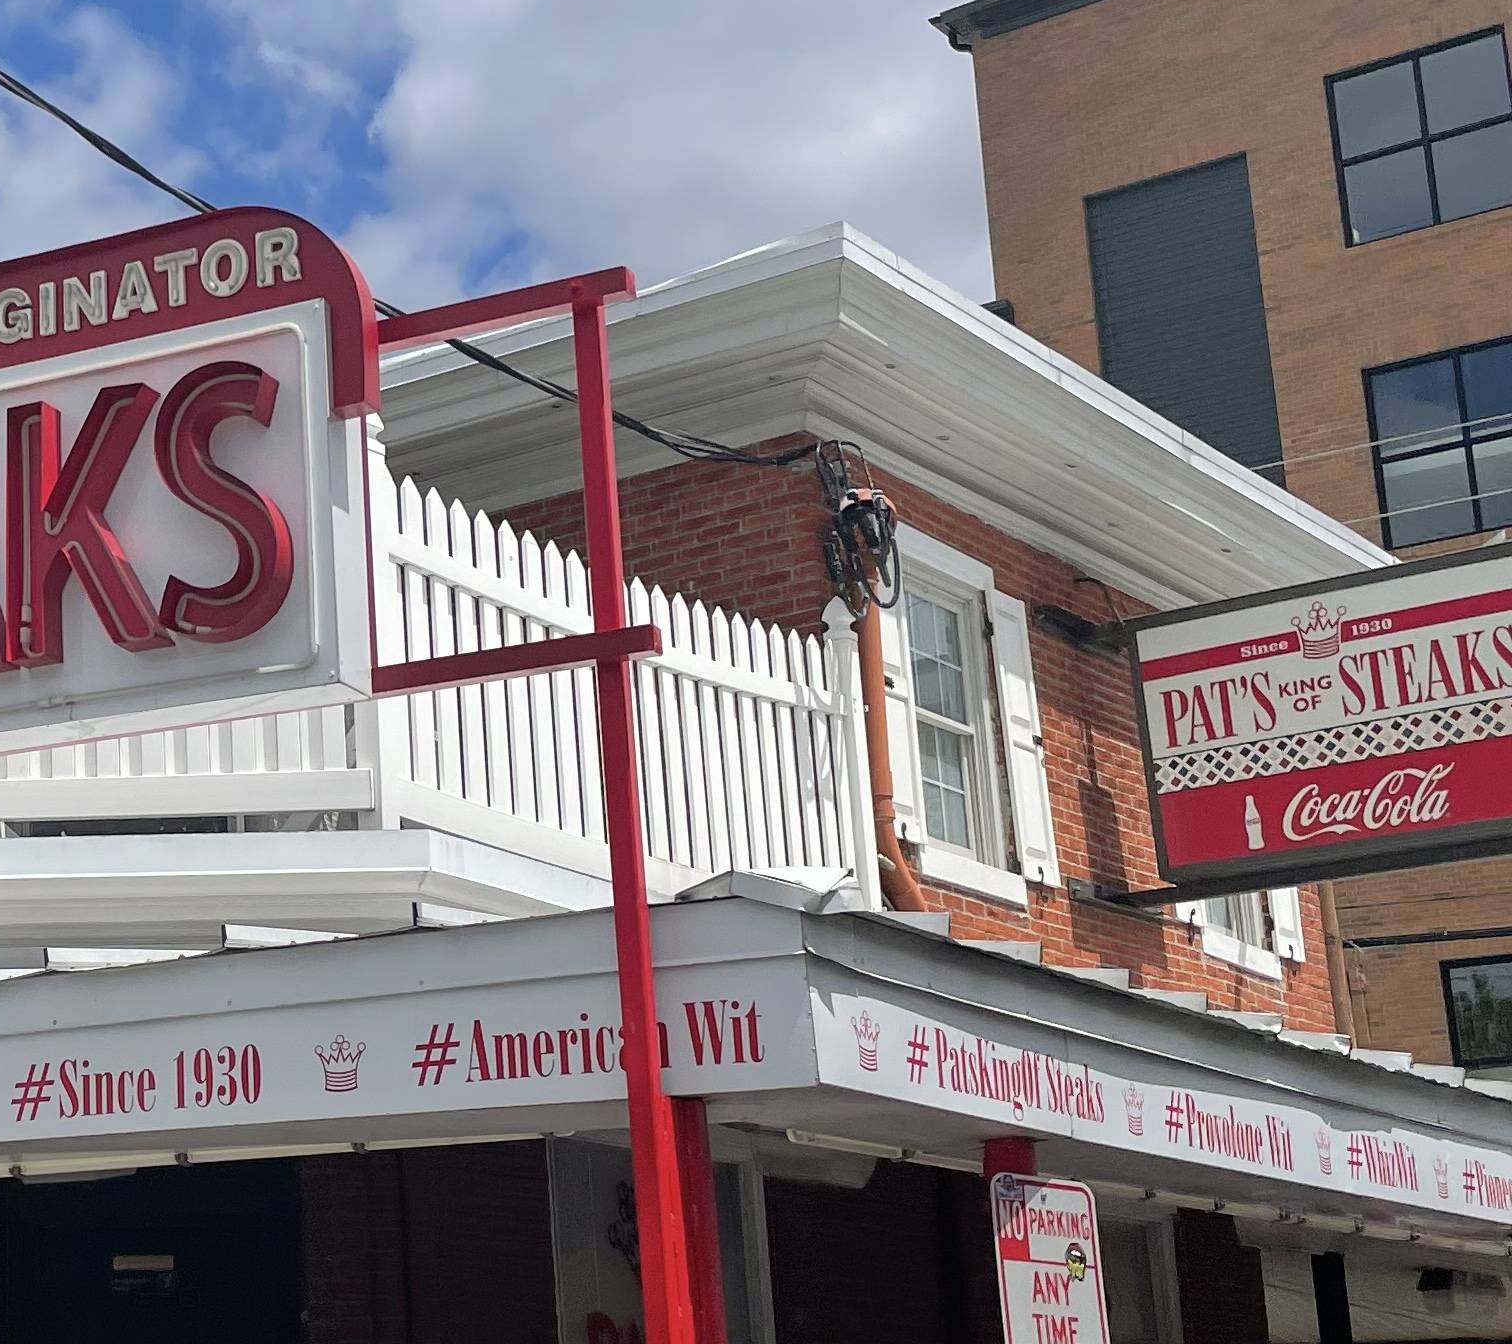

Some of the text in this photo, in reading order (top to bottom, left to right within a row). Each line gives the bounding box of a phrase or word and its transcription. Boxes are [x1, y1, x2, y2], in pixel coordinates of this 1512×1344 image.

[1239, 618, 1393, 659] Since 1930
[1159, 671, 1278, 750] PAT'S
[1278, 674, 1333, 699] KING
[1293, 695, 1323, 713] OF
[411, 999, 766, 1088] #Americn Wit
[10, 1043, 263, 1123] #Since 1930
[1045, 1054, 1106, 1124] Steaks
[1164, 1089, 1295, 1173] #Provolone Wit
[998, 1199, 1091, 1241] NO PARKING
[1032, 1270, 1072, 1307] ANY
